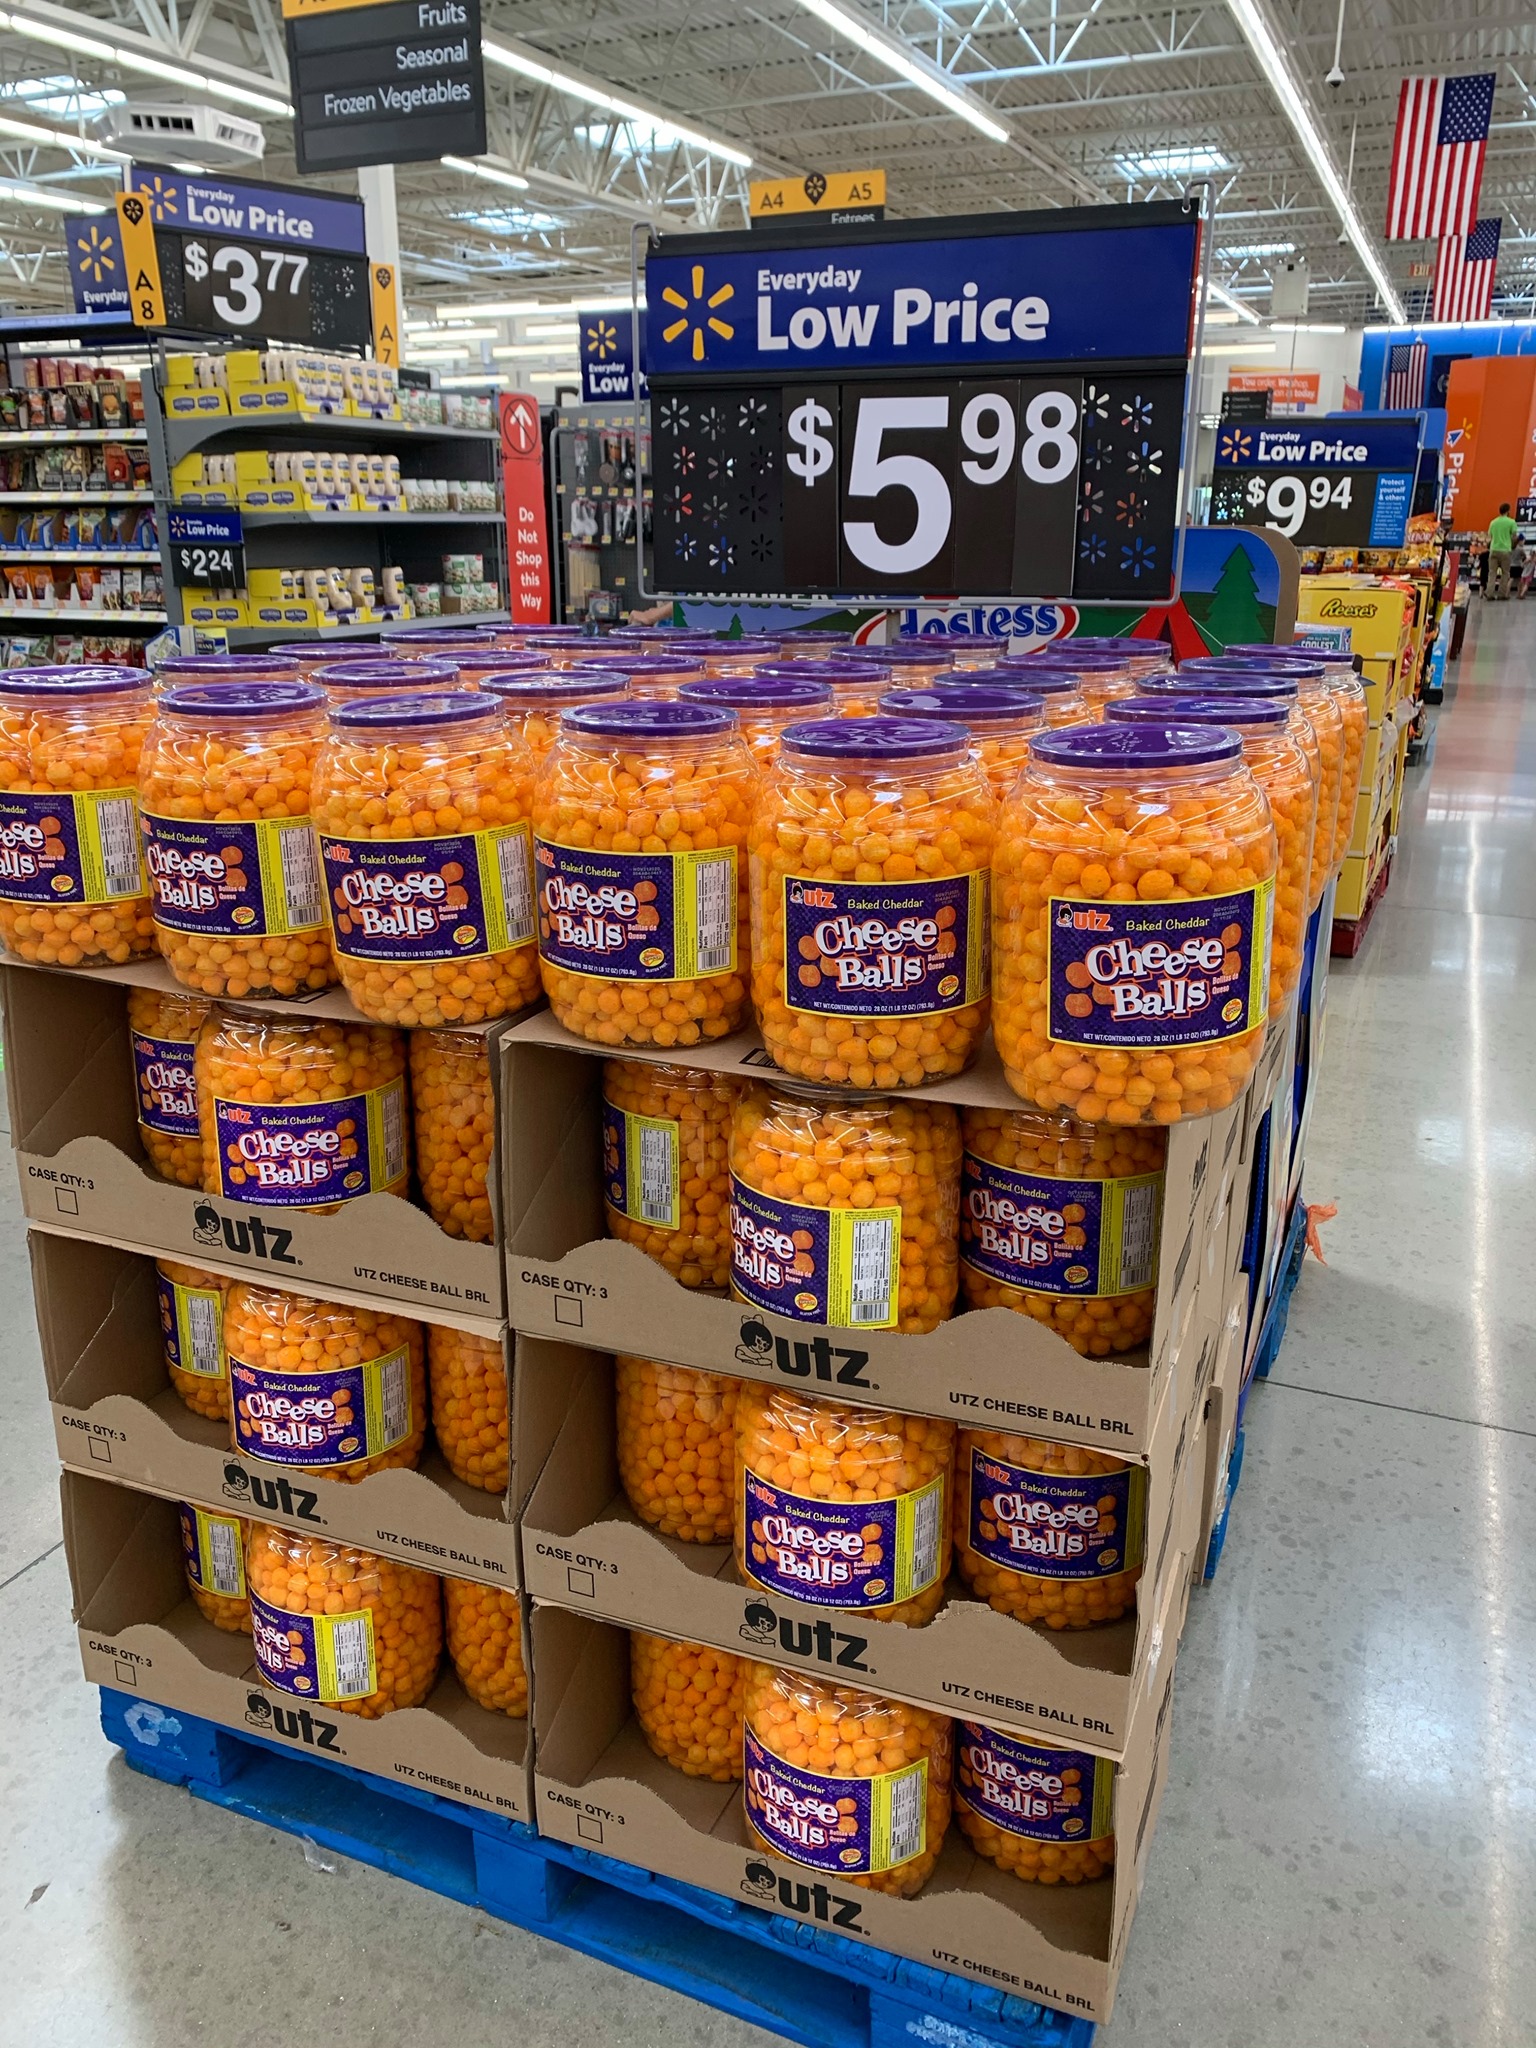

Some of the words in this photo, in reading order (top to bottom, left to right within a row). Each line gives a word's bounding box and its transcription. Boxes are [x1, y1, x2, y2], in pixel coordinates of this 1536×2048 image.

[418, 1, 468, 28] Fruits
[396, 37, 469, 70] Seasonal
[324, 93, 377, 117] Frozen
[378, 78, 471, 113] Vegetables
[186, 185, 235, 205] Everyday
[760, 190, 785, 209] A4
[848, 182, 873, 201] A5
[187, 197, 245, 229] Low
[249, 205, 315, 240] Price
[757, 265, 862, 296] Everyday
[83, 288, 129, 305] Everyday
[757, 296, 880, 351] Low
[892, 281, 1051, 347] Price
[588, 361, 626, 374] Everyday
[589, 373, 629, 394] Low
[1258, 440, 1306, 462] Low
[1309, 440, 1368, 462] Price
[1260, 431, 1301, 443] Everyday
[1379, 485, 1406, 494] yourself
[1380, 478, 1405, 486] Protect
[1384, 493, 1406, 501] others
[187, 522, 206, 536] Low
[206, 523, 230, 537] Price
[518, 506, 535, 522] Do
[518, 528, 538, 544] Not
[515, 550, 542, 569] Shop
[520, 571, 540, 587] this
[520, 593, 542, 612] Way
[147, 844, 226, 880] Cheese
[330, 844, 352, 863] utz
[360, 854, 386, 864] Baked
[388, 854, 427, 865] Cheddar
[560, 860, 584, 874] Baked
[585, 866, 621, 879] Cheddar
[157, 878, 215, 911] Balls
[341, 870, 447, 906] Cheese
[545, 876, 638, 918] Cheese
[803, 887, 835, 909] utz
[847, 899, 880, 910] Baked
[882, 898, 924, 910] Cheddar
[359, 905, 436, 937] Balls
[556, 914, 623, 950] Balls
[1073, 909, 1111, 931] utz
[1125, 920, 1162, 932] Baked
[1165, 916, 1210, 931] Cheddar
[814, 916, 938, 956] Cheese
[835, 955, 924, 988] Balls
[1086, 938, 1224, 983] Cheese
[1212, 974, 1232, 986] Bolitas
[1212, 985, 1230, 995] Queso
[1109, 978, 1208, 1018] Balls
[1083, 1032, 1094, 1040] NET
[1161, 1034, 1169, 1042] OZ
[227, 1108, 252, 1124] utz
[238, 1130, 340, 1161] Cheese
[28, 1166, 59, 1182] CASE
[60, 1172, 86, 1188] QTY:
[87, 1179, 95, 1190] 3
[256, 1159, 329, 1186] Balls
[969, 1189, 1065, 1236] Cheese
[220, 1215, 297, 1266] utz
[729, 1204, 795, 1260] Cheese
[980, 1223, 1048, 1264] Balls
[733, 1240, 781, 1285] Balls
[353, 1265, 378, 1281] UTZ
[379, 1271, 429, 1291] CHEESE
[430, 1281, 463, 1299] BALL
[465, 1288, 491, 1305] BRL
[521, 1270, 560, 1289] CASE
[563, 1279, 596, 1297] QTY:
[599, 1287, 608, 1299] 3
[774, 1336, 872, 1390] utz
[245, 1392, 336, 1422] Cheese
[949, 1391, 980, 1409] UTZ
[982, 1397, 1049, 1421] CHEESE
[1051, 1408, 1097, 1430] BALL
[1099, 1417, 1134, 1436] BRL
[62, 1415, 91, 1432] CASE
[93, 1424, 118, 1440] QTY:
[119, 1432, 127, 1442] 3
[259, 1421, 324, 1447] Balls
[985, 1464, 1011, 1484] utz
[1020, 1481, 1048, 1495] Baked
[1050, 1487, 1087, 1497] Cheddar
[249, 1475, 322, 1524] utz
[785, 1504, 811, 1520] Baked
[812, 1512, 850, 1525] Cheddar
[992, 1493, 1099, 1529] Cheese
[762, 1515, 864, 1556] Cheese
[1008, 1525, 1084, 1557] Balls
[376, 1529, 399, 1545] UTZ
[400, 1536, 448, 1557] CHEESE
[449, 1548, 481, 1567] BALL
[483, 1558, 508, 1575] BRL
[536, 1543, 573, 1562] CASE
[576, 1554, 607, 1572] QTY:
[610, 1563, 619, 1574] 3
[775, 1549, 849, 1585] Balls
[89, 1640, 118, 1656] CASE
[119, 1649, 144, 1665] QTY:
[145, 1658, 153, 1667] 3
[779, 1615, 869, 1674] utz
[941, 1681, 971, 1698] UTZ
[973, 1688, 1035, 1714] CHEESE
[1037, 1705, 1080, 1727] BALL
[1082, 1716, 1114, 1735] BRL
[272, 1708, 341, 1755] utz
[969, 1746, 1063, 1796] Cheese
[394, 1762, 416, 1777] UTZ
[417, 1770, 462, 1793] CHEESE
[463, 1785, 494, 1804] BALL
[495, 1795, 519, 1812] BRL
[753, 1768, 839, 1824] Cheese
[980, 1777, 1049, 1818] Balls
[547, 1790, 582, 1810] CASE
[585, 1803, 615, 1822] QTY:
[617, 1815, 625, 1825] 3
[763, 1800, 826, 1845] Balls
[778, 1876, 863, 1935] utz
[932, 1948, 960, 1966] UTZ
[962, 1958, 1020, 1985] CHEESE
[1023, 1978, 1062, 2001] BALL
[1065, 1992, 1096, 2012] BRL
